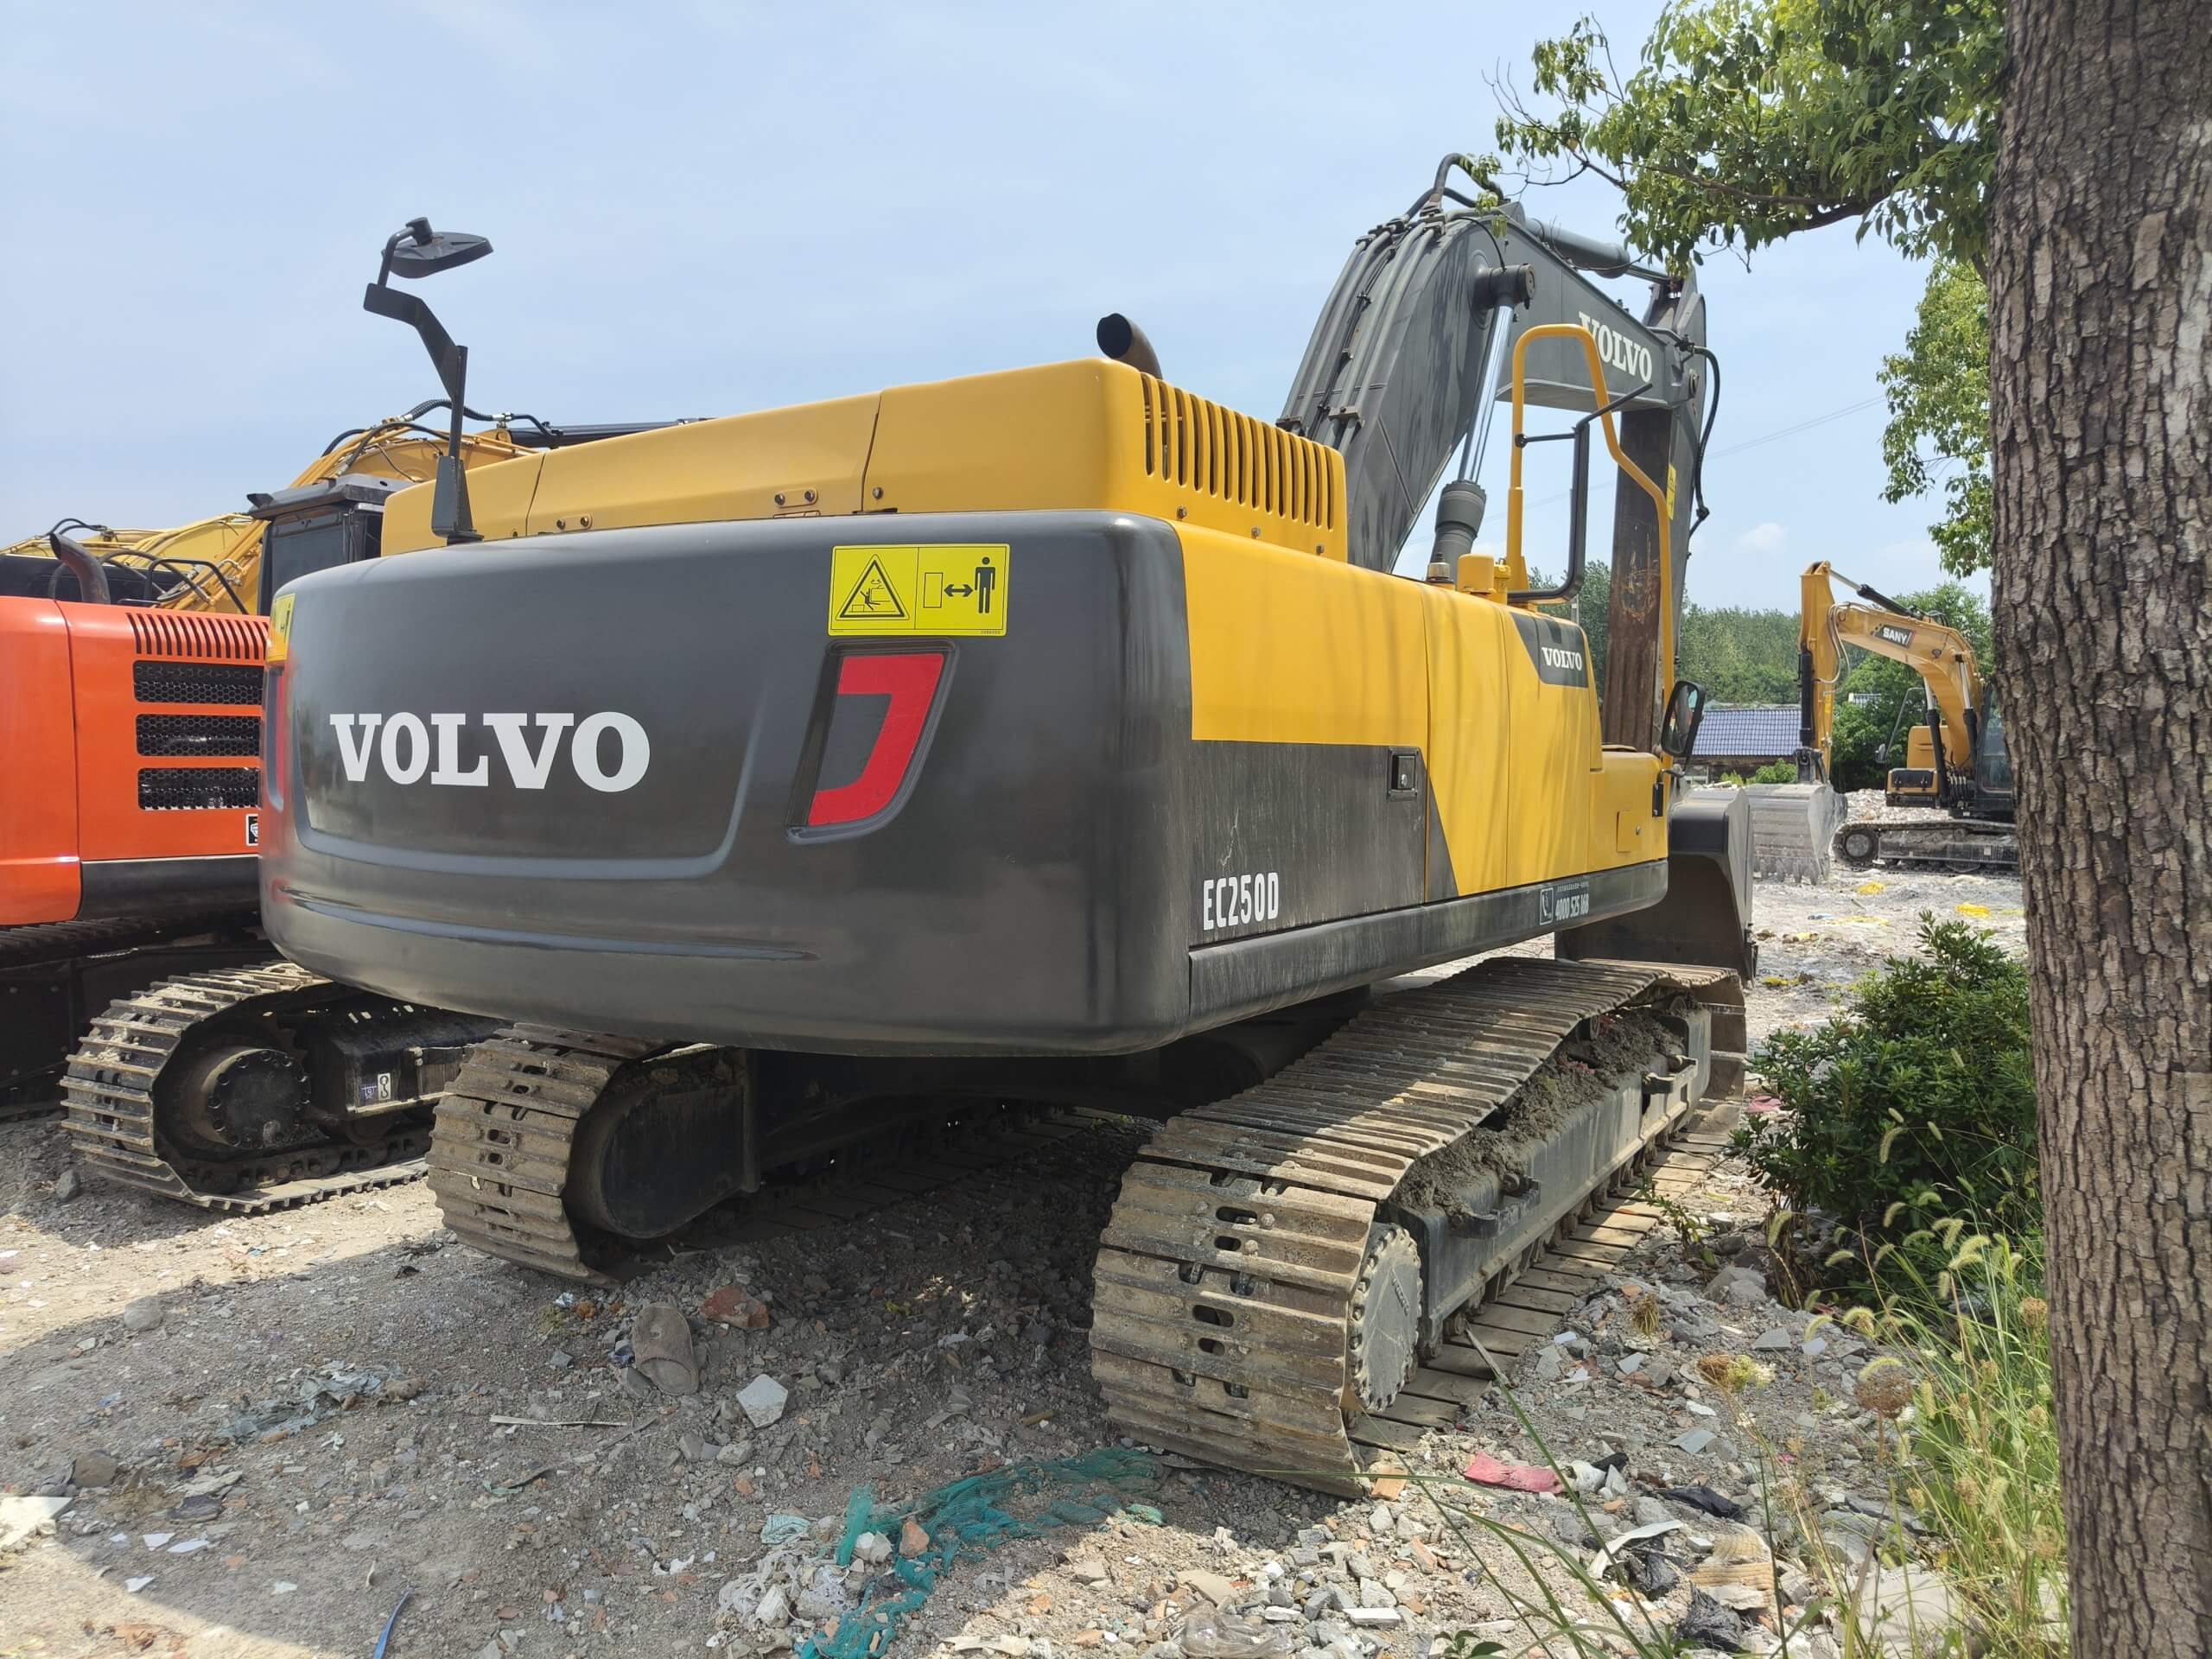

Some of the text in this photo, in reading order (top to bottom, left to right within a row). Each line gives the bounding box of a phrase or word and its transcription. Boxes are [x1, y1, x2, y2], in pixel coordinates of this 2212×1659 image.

[1884, 627, 1907, 645] SANY
[1541, 647, 1582, 671] VOLVO
[329, 711, 650, 792] VOLVO
[1204, 872, 1279, 931] EC250D
